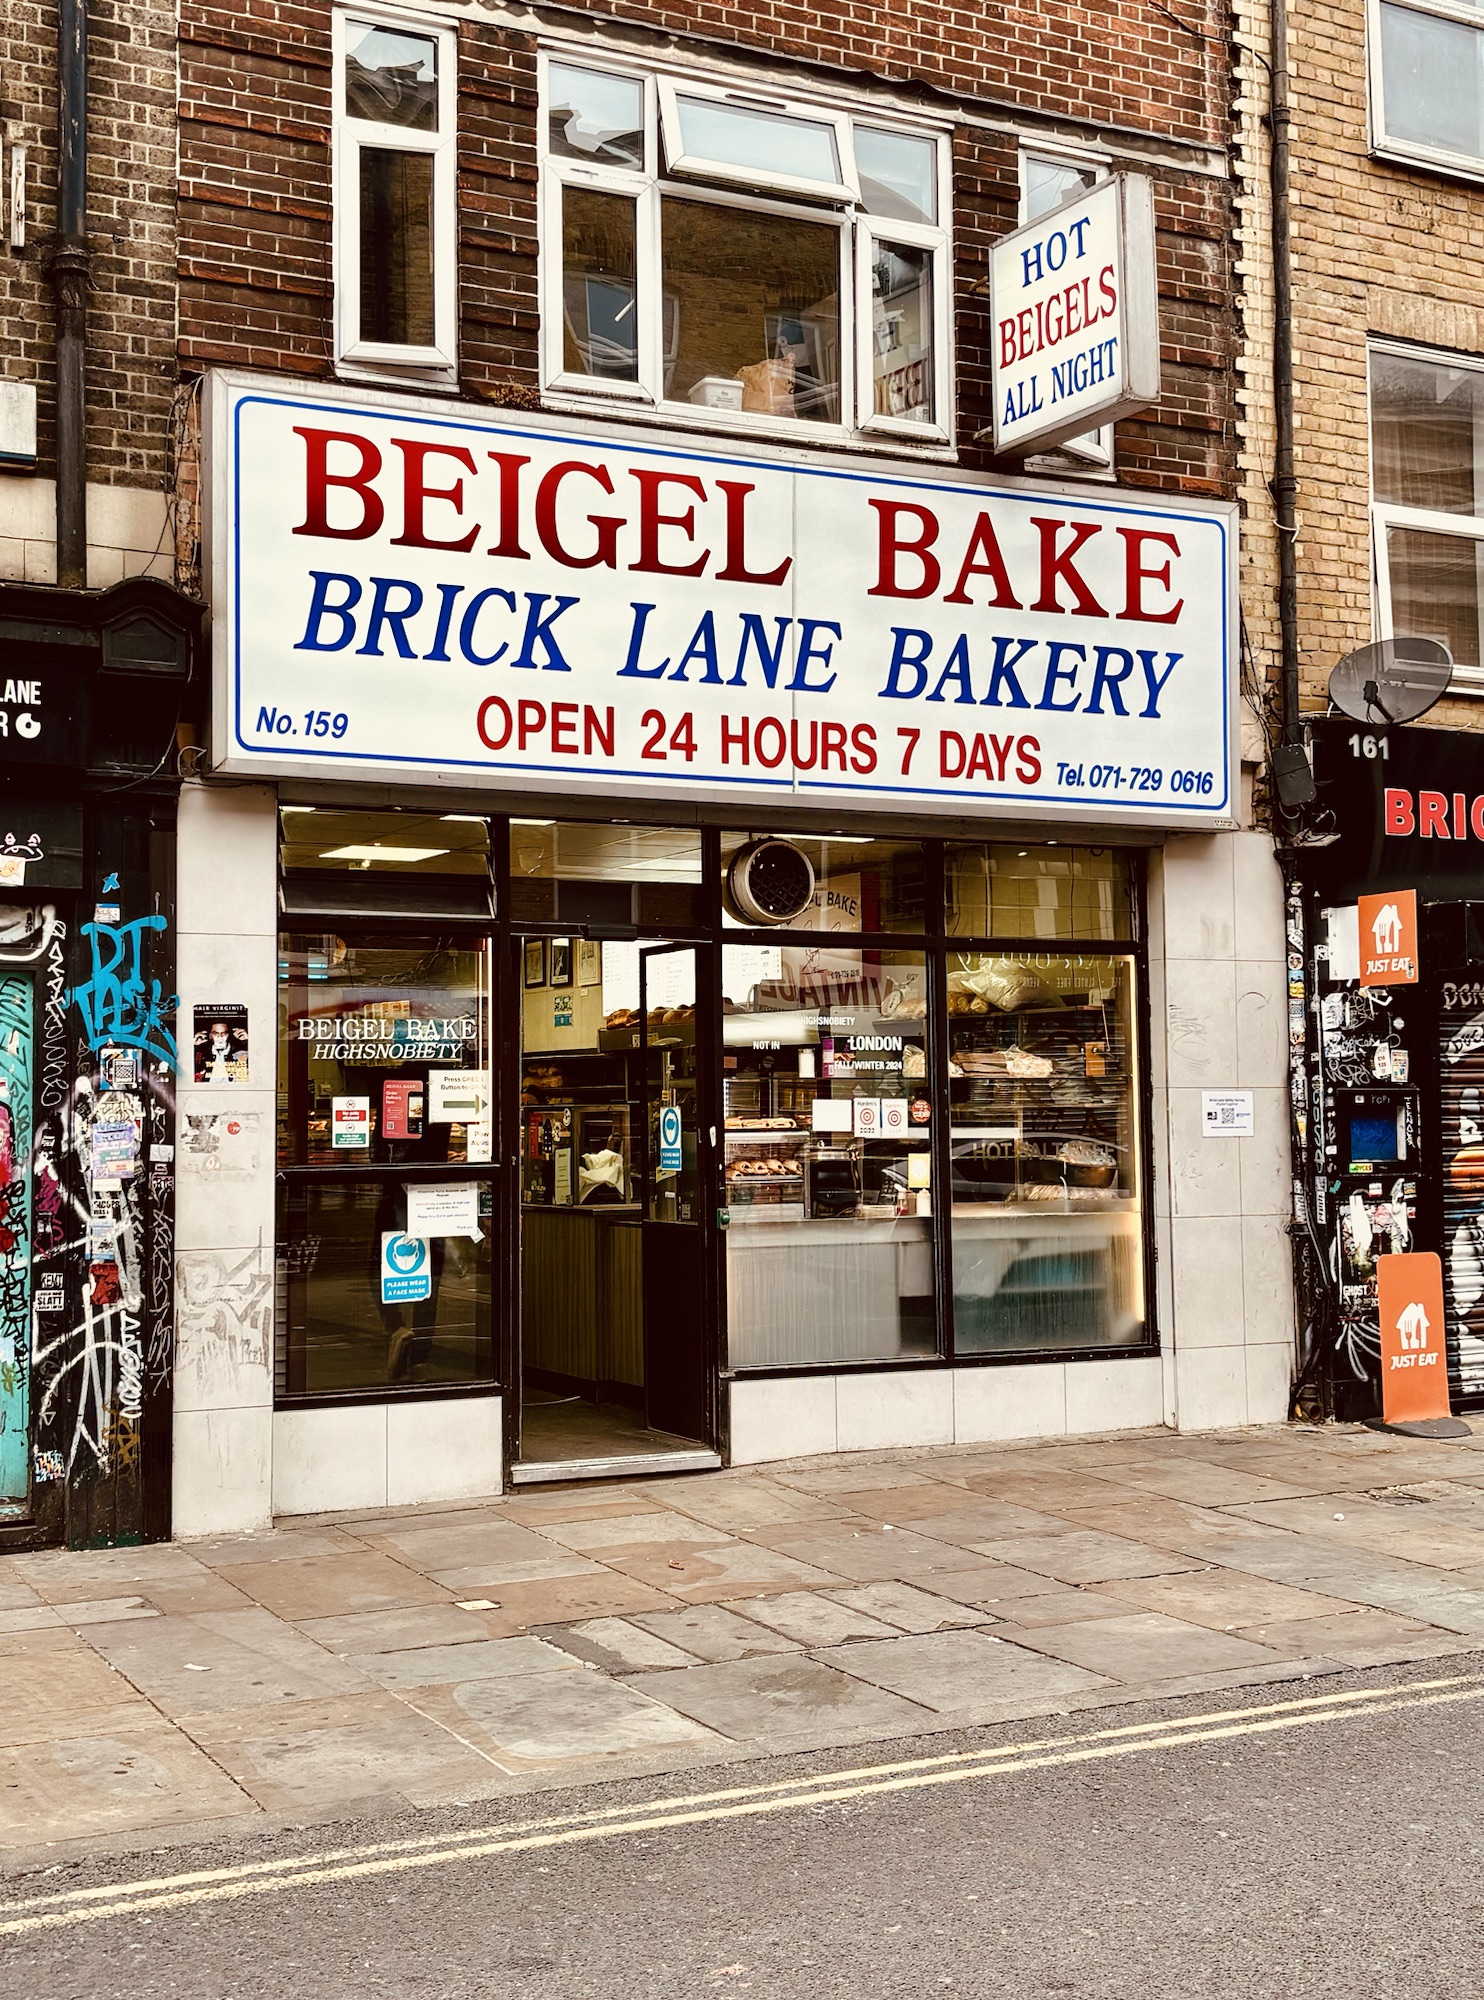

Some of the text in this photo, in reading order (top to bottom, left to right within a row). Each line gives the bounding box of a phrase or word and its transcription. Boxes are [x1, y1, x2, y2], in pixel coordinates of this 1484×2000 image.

[1020, 216, 1091, 287] HOT
[999, 264, 1117, 369] BEIGELS
[1002, 337, 1118, 426] ALL NIGHT
[292, 425, 1184, 625] BEIGEL BAKE
[293, 570, 1184, 719] BRICK LANE BAKERY
[477, 695, 1041, 785] OPEN 24 HOURS 7 DAYS
[1349, 733, 1390, 760] 161
[1170, 771, 1214, 795] 0616
[827, 891, 857, 916] BAKE
[1366, 957, 1411, 976] JUST EAT
[297, 1018, 478, 1041] BEIGEL BAKE
[800, 1016, 856, 1026] HIGHSNOBIETY
[312, 1043, 464, 1060] HIGHSNOBIETY
[753, 1040, 781, 1050] NOT IN
[849, 1035, 902, 1051] LONDON
[834, 1060, 903, 1070] FALL/WINTER 2024
[1390, 1352, 1439, 1371] JUST EAT
